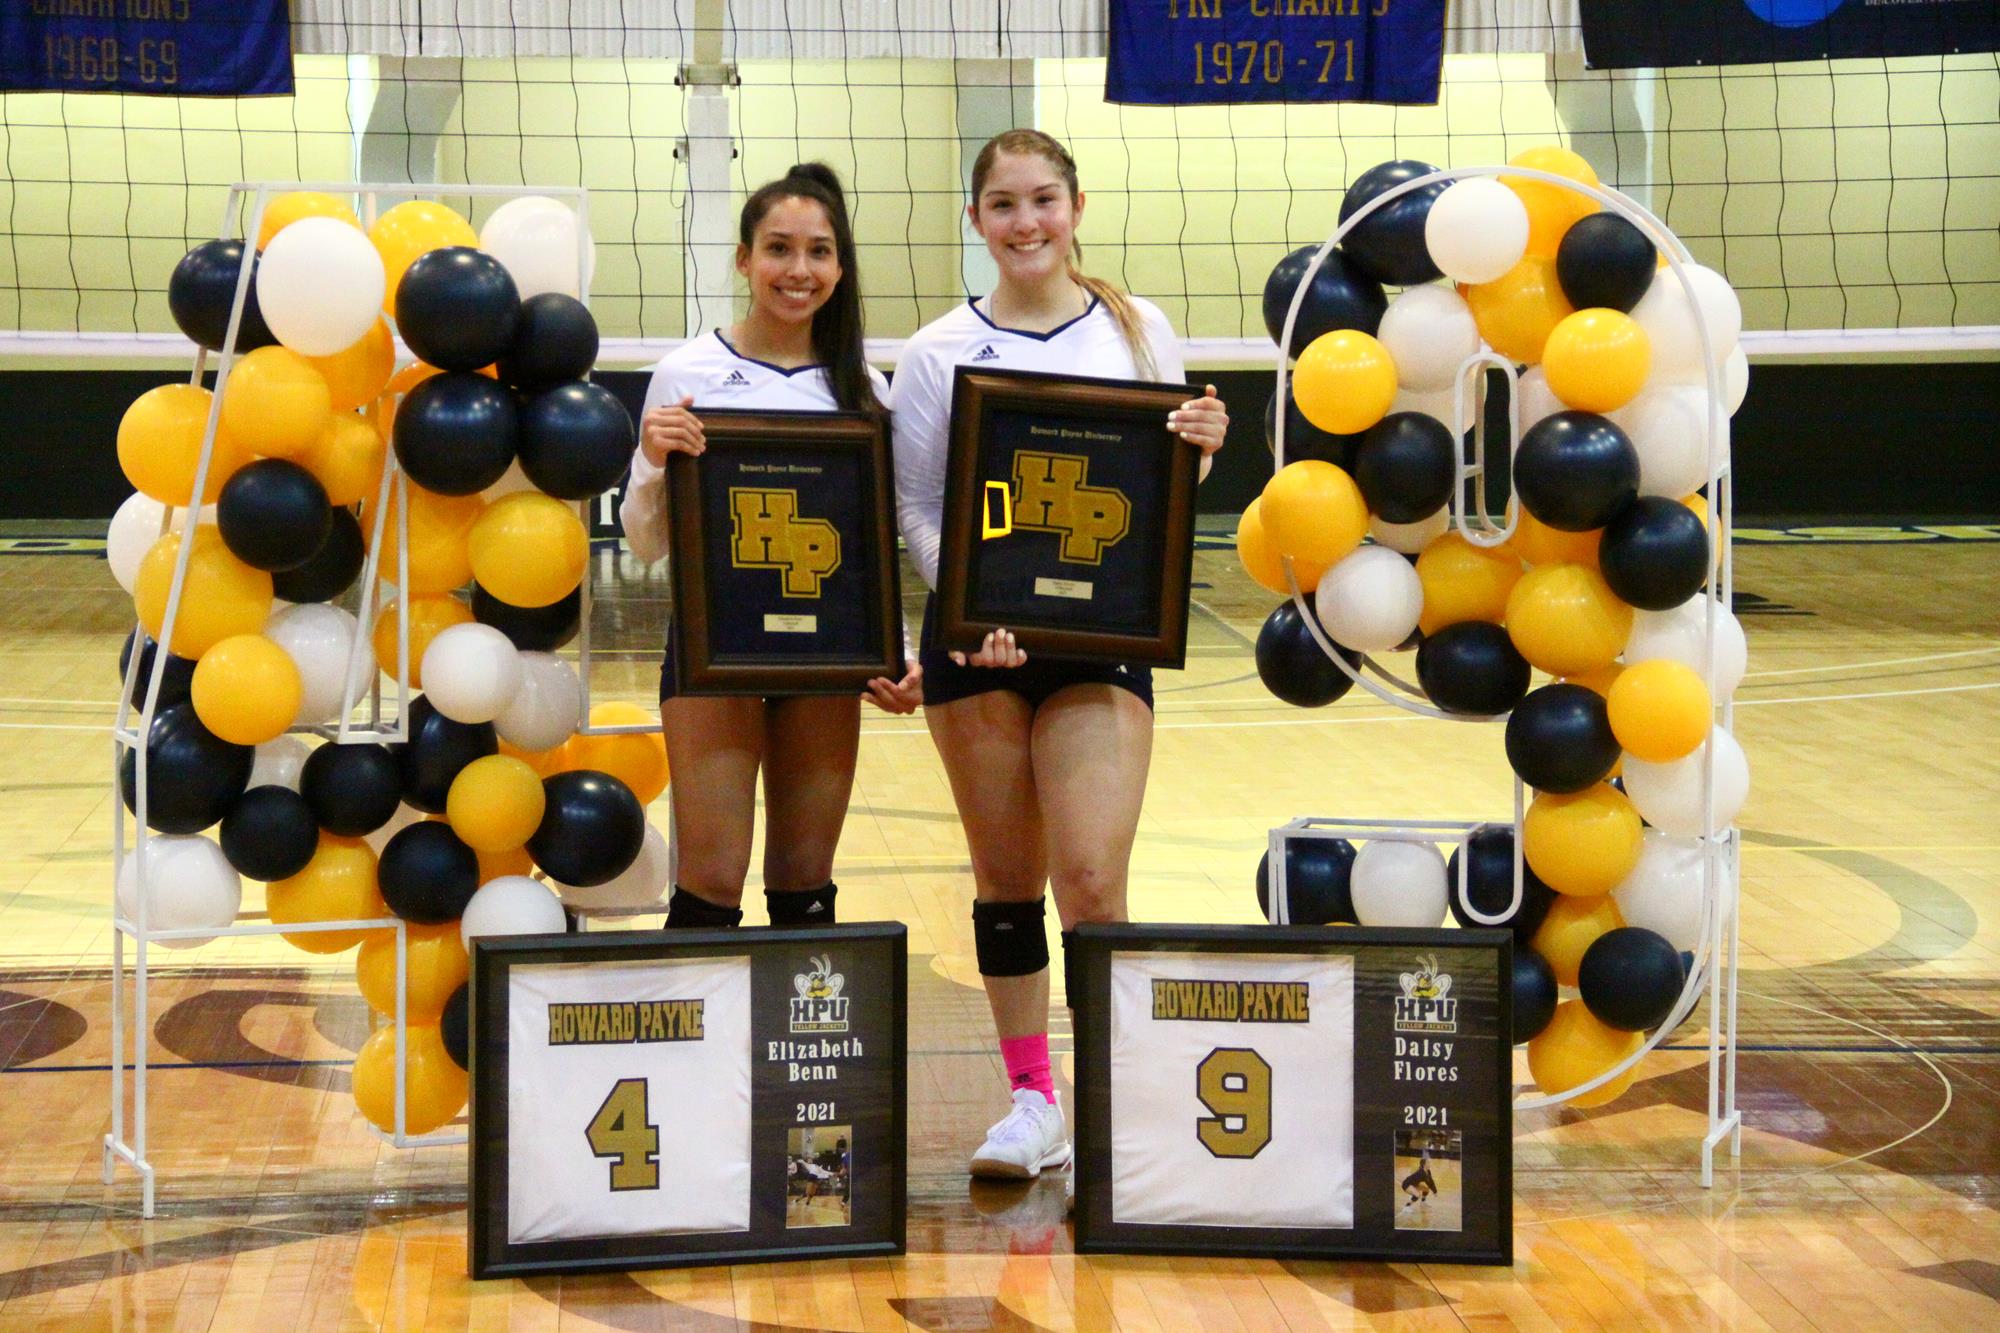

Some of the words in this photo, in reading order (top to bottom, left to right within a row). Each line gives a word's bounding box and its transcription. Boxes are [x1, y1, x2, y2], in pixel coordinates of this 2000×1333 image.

[44, 35, 179, 84] 1968-69
[791, 999, 849, 1022] HPU
[1152, 979, 1238, 1021] HOWARD
[1240, 982, 1309, 1022] PAYNE
[1396, 998, 1456, 1023] HPU
[549, 1002, 636, 1044] HOWARD
[637, 999, 704, 1042] PAYNE
[767, 1037, 864, 1061] Elizabeth
[1394, 1036, 1454, 1061] Daisy
[788, 1062, 838, 1082] Benn
[1394, 1060, 1458, 1082] Flores
[796, 1102, 836, 1122] 2021
[1196, 1047, 1272, 1159] 9
[1403, 1105, 1448, 1126] 2021
[584, 1077, 660, 1192] 4
